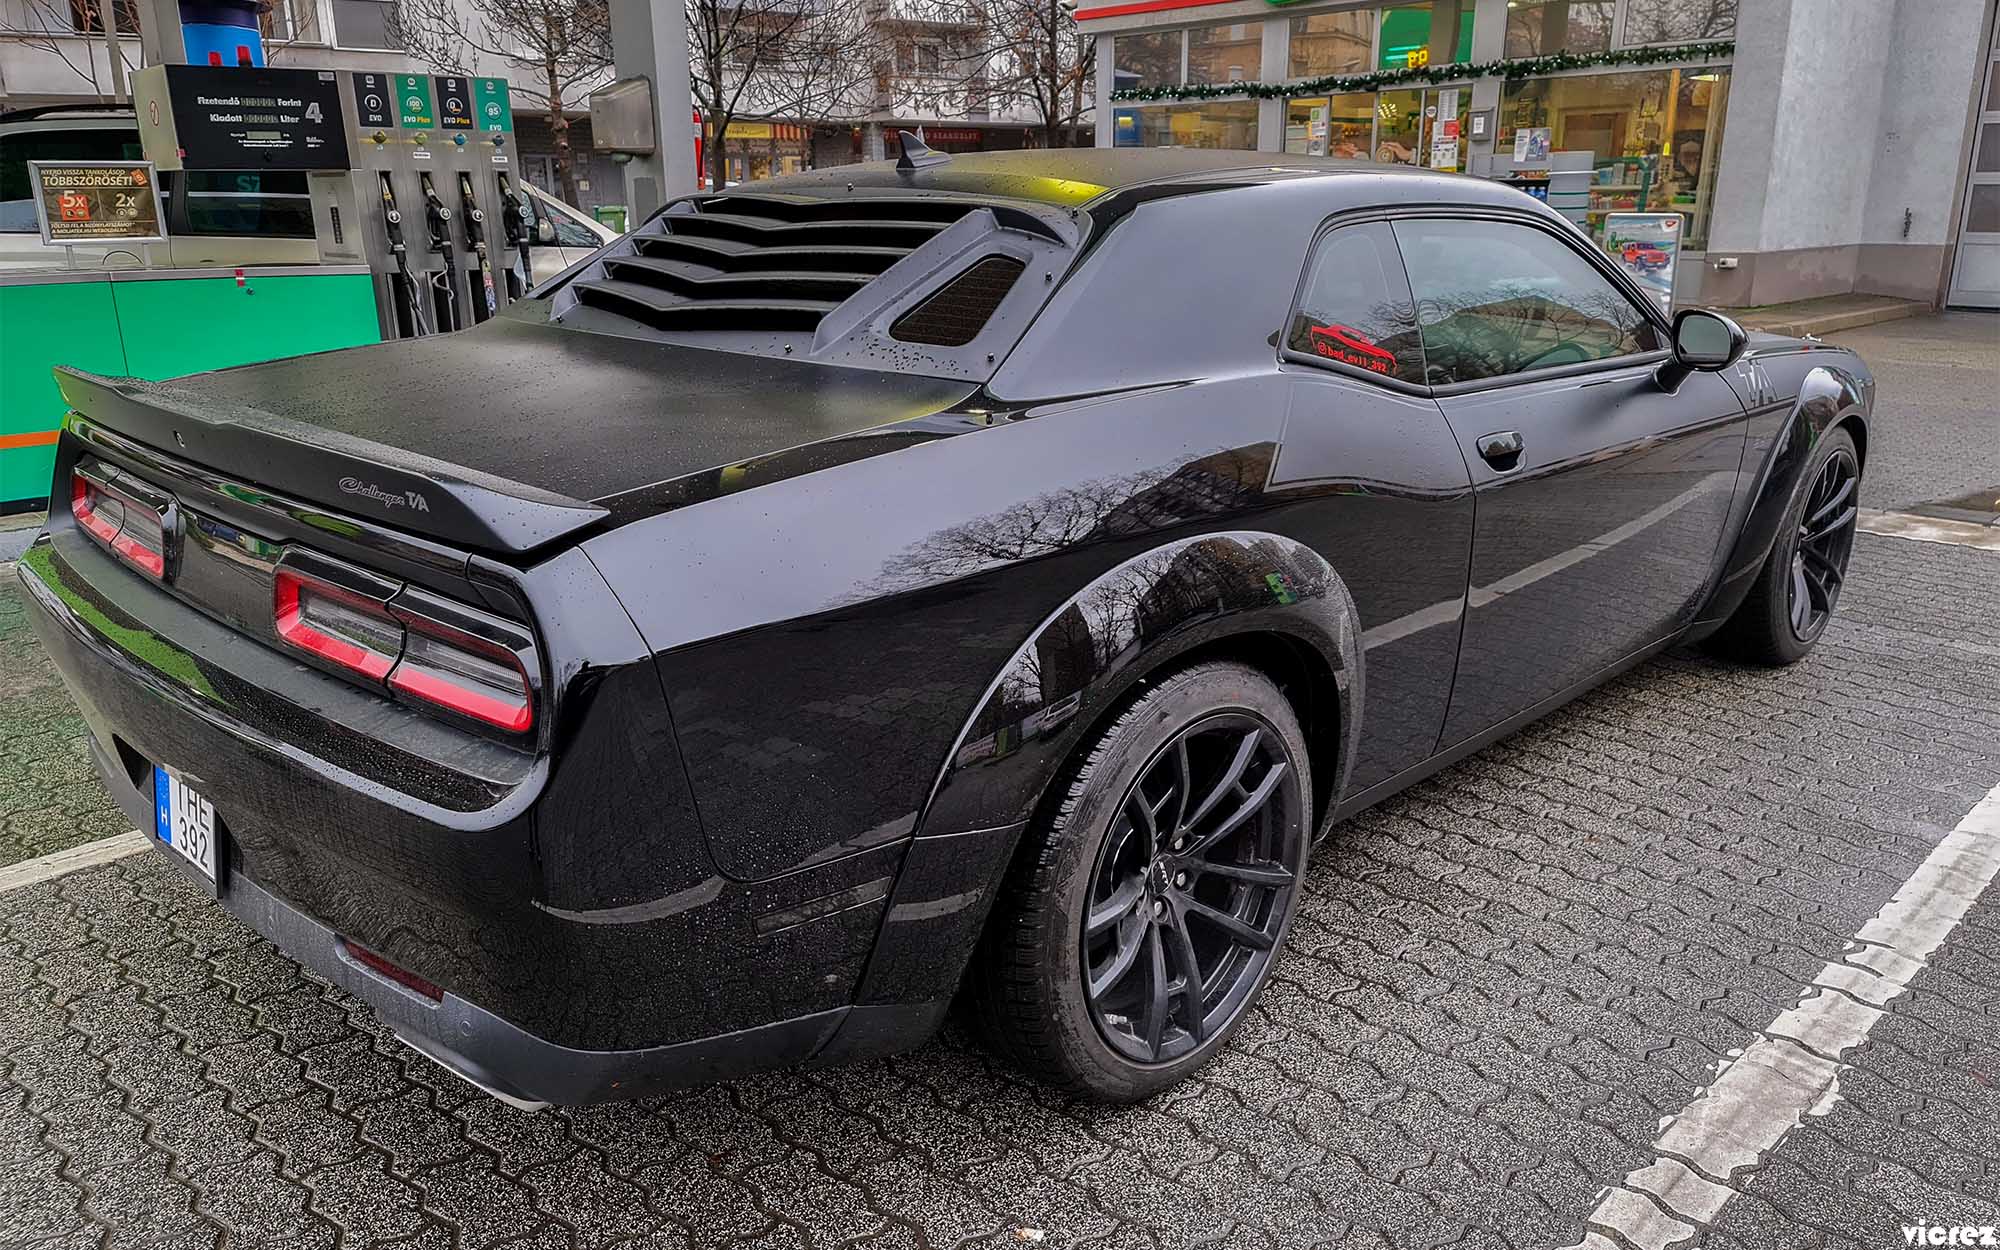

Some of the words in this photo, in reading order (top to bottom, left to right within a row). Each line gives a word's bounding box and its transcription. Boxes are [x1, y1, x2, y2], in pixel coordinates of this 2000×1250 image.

[277, 99, 302, 107] Forint
[210, 113, 243, 123] Kiadott
[280, 115, 300, 123] Liter
[305, 102, 323, 124] 4
[488, 107, 499, 116] 95
[403, 115, 416, 123] EVO
[443, 116, 457, 124] EVO
[63, 190, 85, 208] 5x
[115, 193, 135, 207] 2x
[338, 477, 405, 508] Challenger
[160, 805, 168, 826] H
[179, 816, 208, 868] 392
